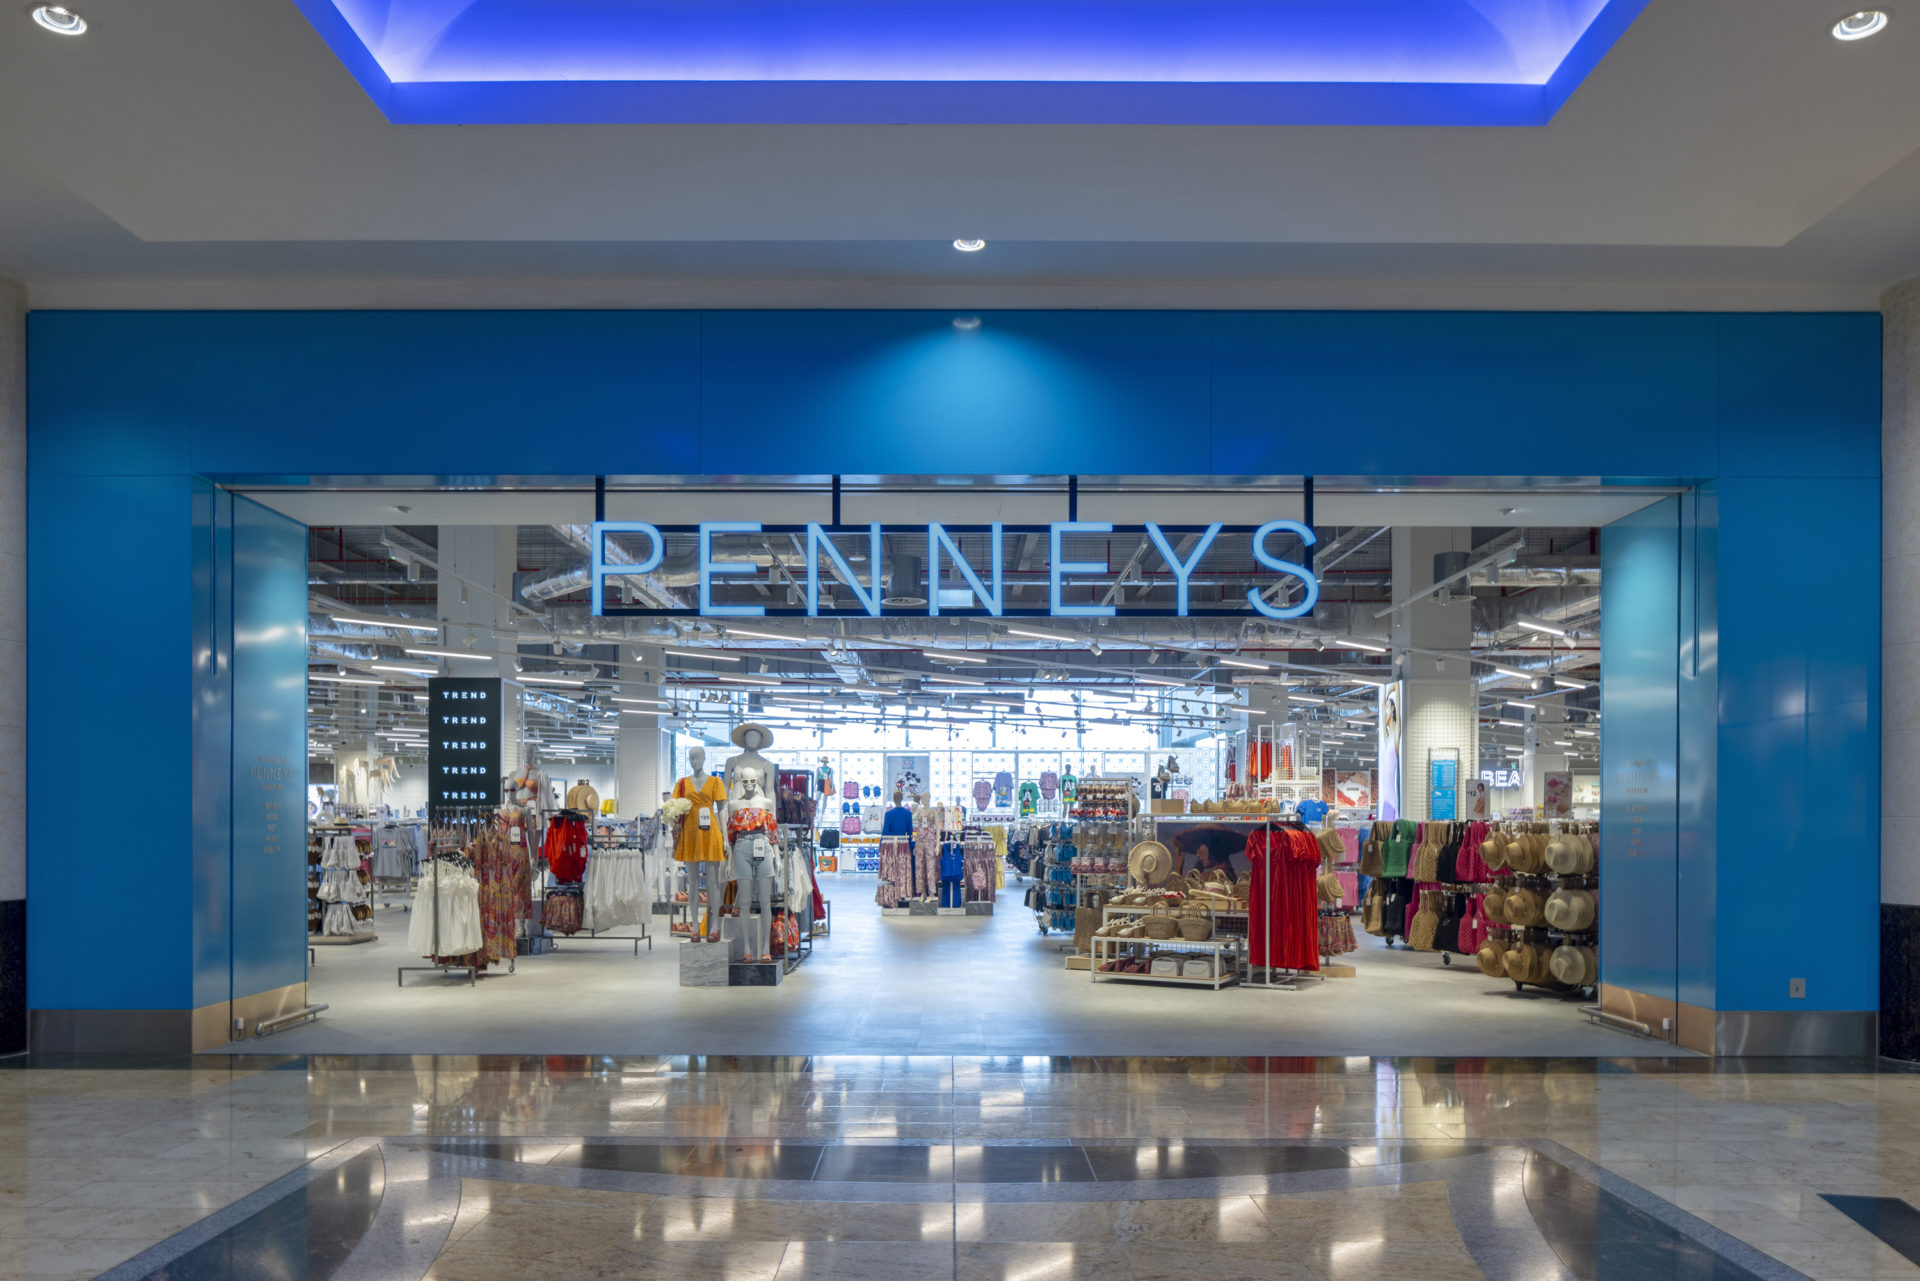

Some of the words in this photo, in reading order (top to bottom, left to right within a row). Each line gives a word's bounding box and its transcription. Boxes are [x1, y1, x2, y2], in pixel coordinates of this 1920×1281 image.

[591, 520, 1319, 618] PENNEYS
[443, 691, 487, 699] TREND
[443, 716, 487, 724] TREND
[443, 741, 487, 749] TREND
[443, 766, 487, 774] TREND
[1481, 770, 1525, 787] BEA
[443, 791, 487, 799] TREND
